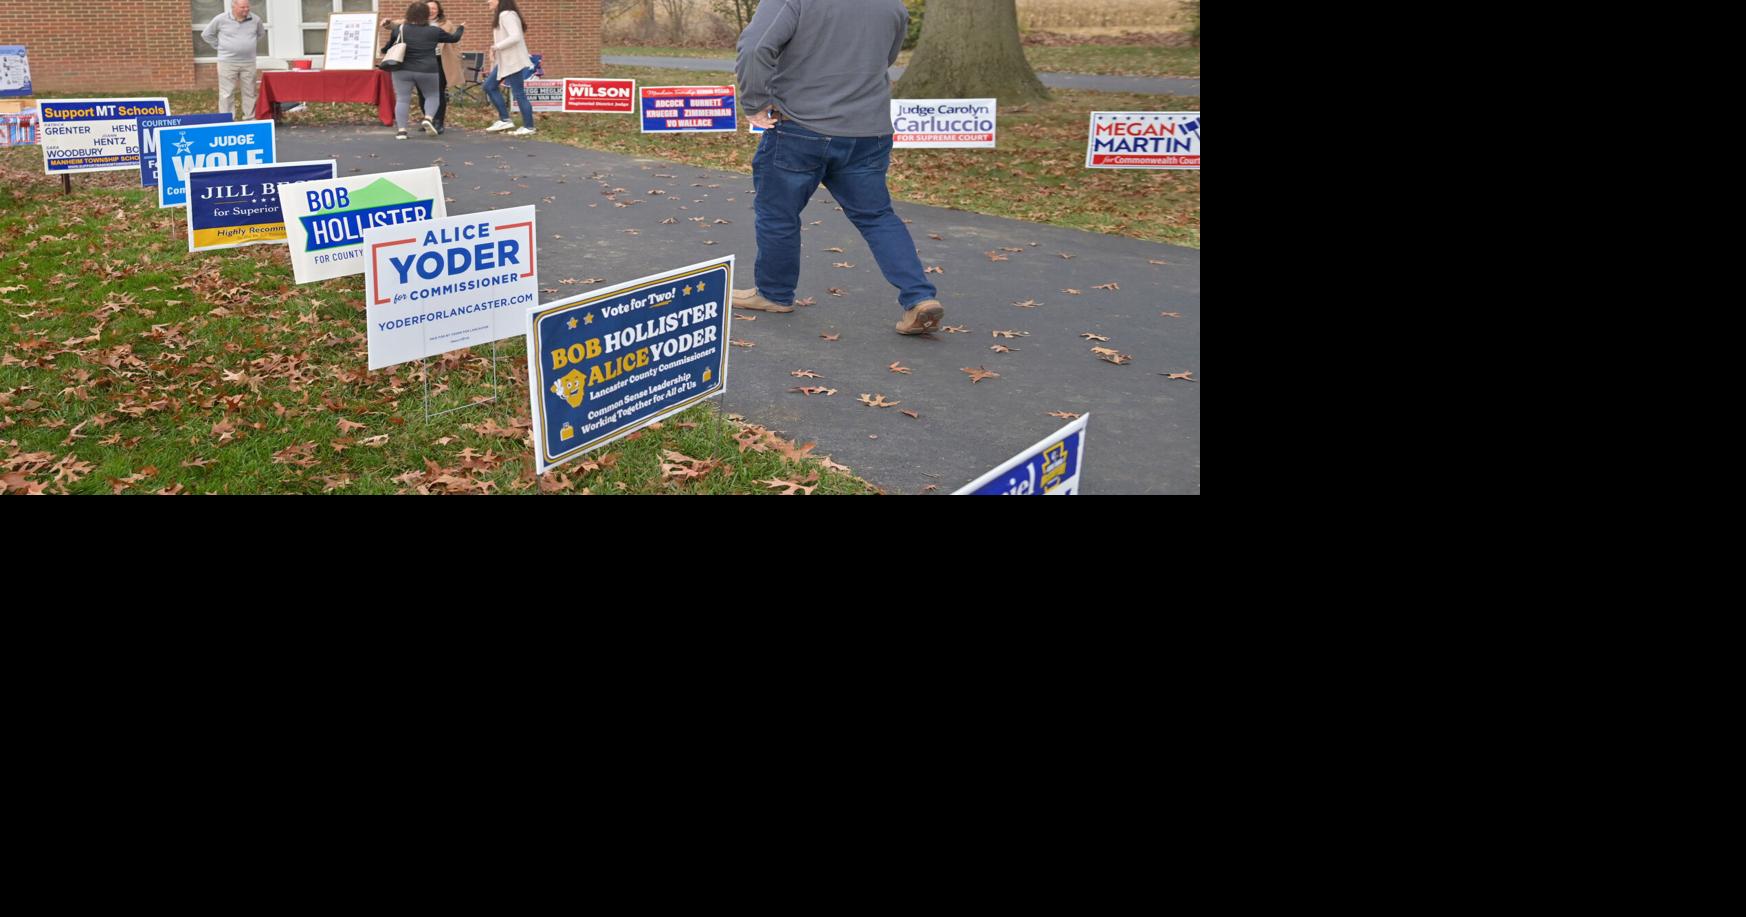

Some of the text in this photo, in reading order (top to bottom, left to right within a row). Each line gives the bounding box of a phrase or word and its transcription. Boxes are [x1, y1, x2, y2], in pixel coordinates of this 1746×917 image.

[568, 87, 630, 97] WILSON
[655, 99, 685, 108] ADCOCK
[896, 104, 989, 117] Judge Carolyn
[44, 106, 94, 119] Support
[96, 105, 117, 117] MT
[118, 105, 165, 116] Schools
[646, 108, 732, 118] KRUEGER ZIMMERMAN
[44, 124, 138, 136] GRENTER HEND
[141, 119, 182, 128] COURTNEY
[677, 118, 712, 127] WALLACE
[893, 116, 993, 132] Carluccio
[1095, 122, 1176, 137] MEGAN
[93, 137, 127, 147] HENTZ
[209, 134, 255, 148] JUDGE
[1094, 137, 1192, 153] MARTIN
[46, 148, 103, 158] WOODBURY
[84, 156, 119, 164] TOWNSHIP
[1114, 155, 1178, 165] Commonwealth
[200, 184, 254, 200] JILL
[306, 186, 350, 213] BOB
[213, 204, 279, 217] for Superior
[217, 227, 246, 237] Highly
[423, 222, 490, 247] ALICE
[314, 249, 364, 264] FOR COUNTY
[389, 239, 520, 285] YODER
[393, 272, 518, 304] for COMMISSIONER
[601, 287, 677, 319] Vote for Two!
[378, 293, 533, 332] YODERFORLANCASTER.COM
[551, 301, 718, 371] BOB HOLLISTER
[587, 325, 717, 387] ALICE YODER
[589, 346, 716, 401] Lancaster County Commissioners
[587, 372, 692, 421] Common Sense Leadership
[581, 380, 698, 434] Working Together for All of Us
